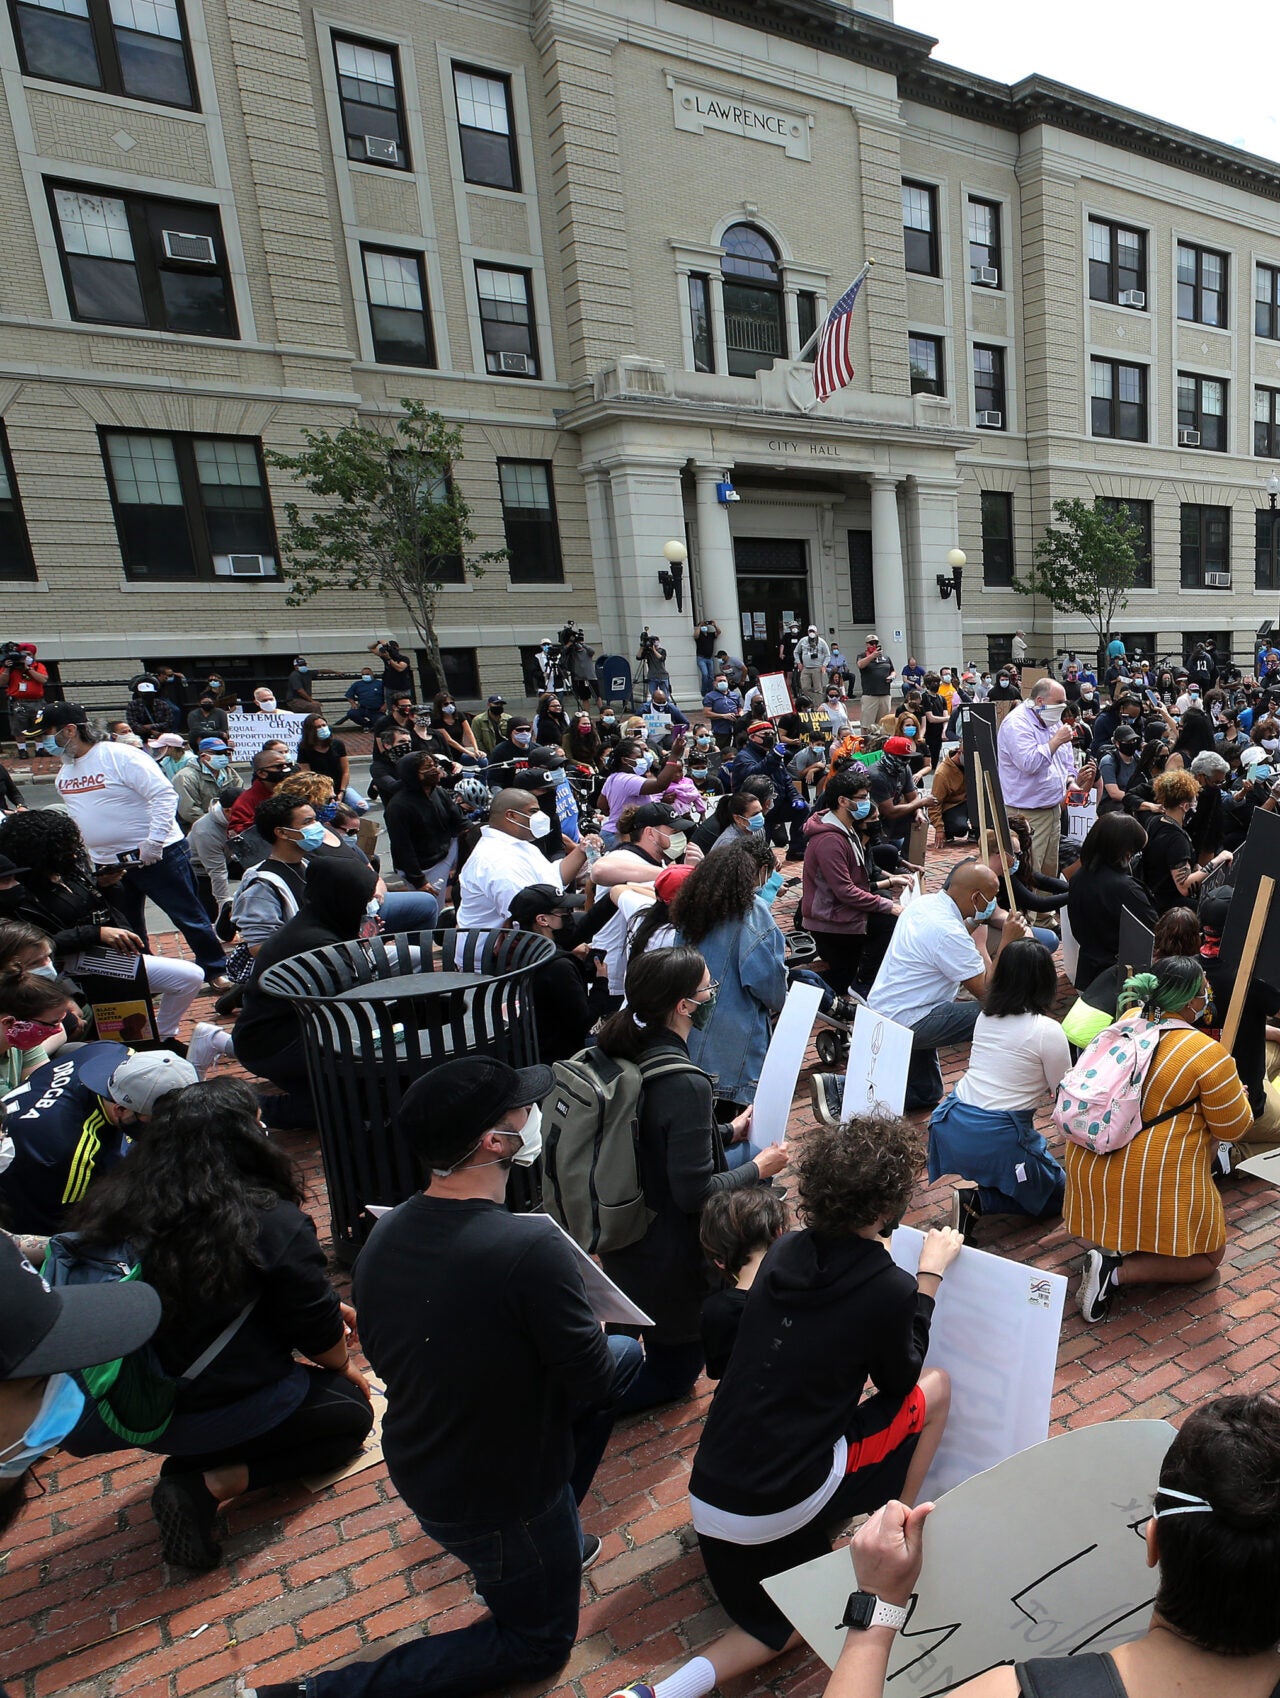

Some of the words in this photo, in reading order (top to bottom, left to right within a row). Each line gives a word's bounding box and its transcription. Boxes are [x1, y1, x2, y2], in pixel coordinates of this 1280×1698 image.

[695, 96, 788, 136] LAWRENCE
[768, 440, 798, 453] CITY
[810, 444, 841, 456] HALL
[228, 713, 285, 722] SYSTEMIC
[798, 712, 809, 722] TU
[810, 711, 831, 722] LUCHA
[812, 722, 820, 731] ES
[19, 1060, 75, 1120] DROGBA
